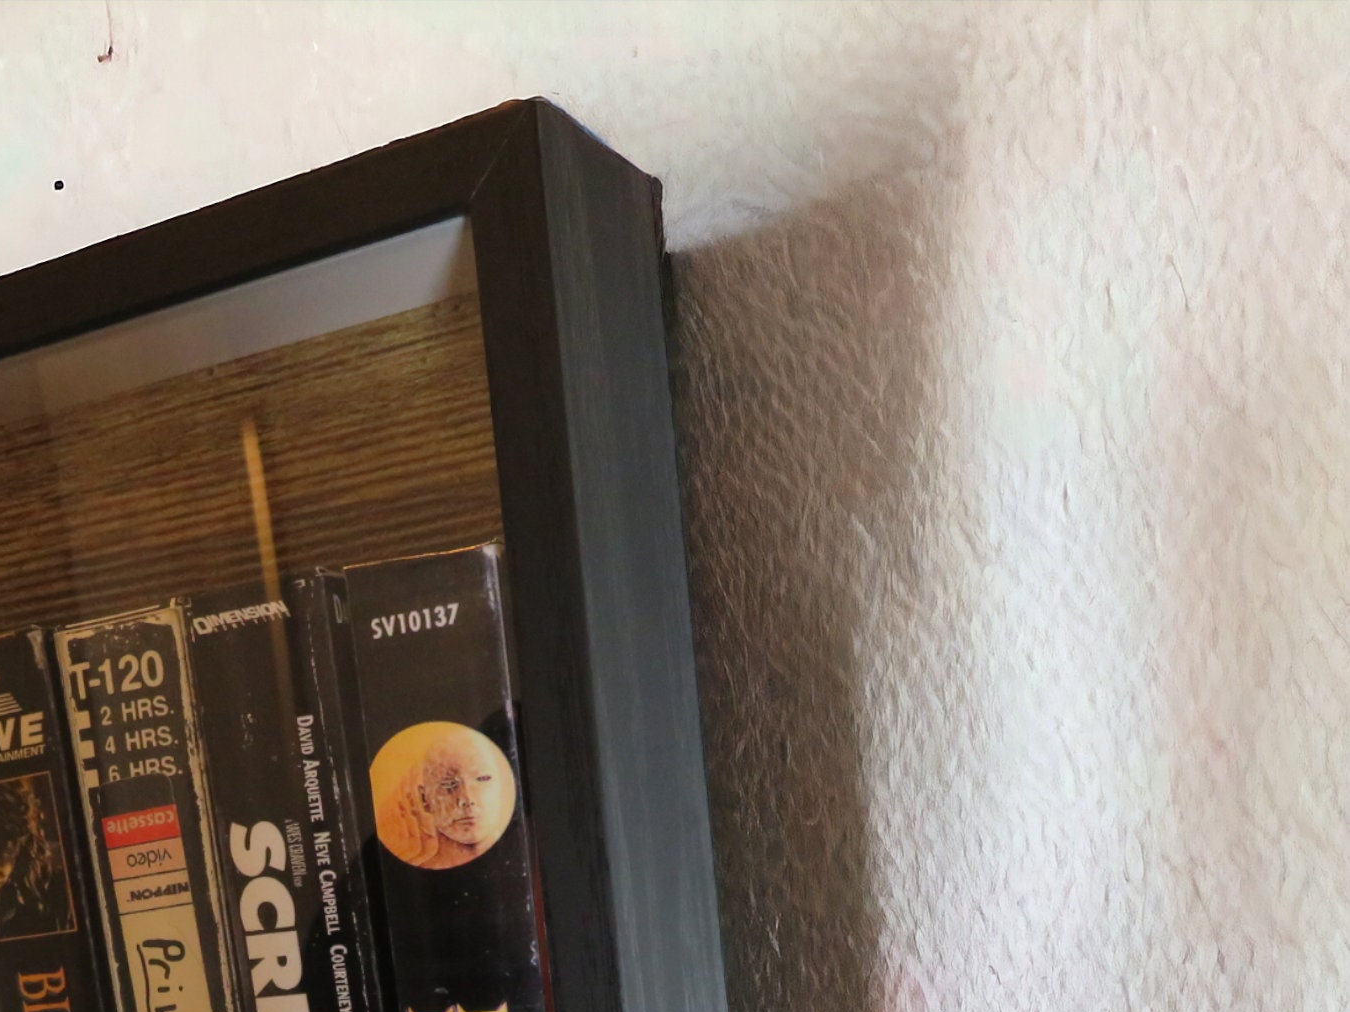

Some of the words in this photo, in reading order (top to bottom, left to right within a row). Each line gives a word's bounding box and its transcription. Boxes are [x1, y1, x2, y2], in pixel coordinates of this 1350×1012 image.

[192, 600, 291, 635] DIMENSION
[370, 603, 460, 640] SV10137
[68, 650, 164, 700] T-120
[100, 706, 112, 726] 2
[121, 695, 174, 722] HRS.
[105, 736, 116, 754] 4
[125, 726, 178, 751] HRS.
[297, 715, 315, 755] DAVID
[108, 765, 120, 782] 6
[129, 756, 183, 779] HRS.
[303, 760, 324, 822] ARQUETTE
[106, 810, 176, 834] cassette
[126, 848, 171, 869] video
[313, 831, 332, 866] NEVE
[130, 881, 189, 902] NIPPON
[318, 870, 340, 935] CAMPBELL
